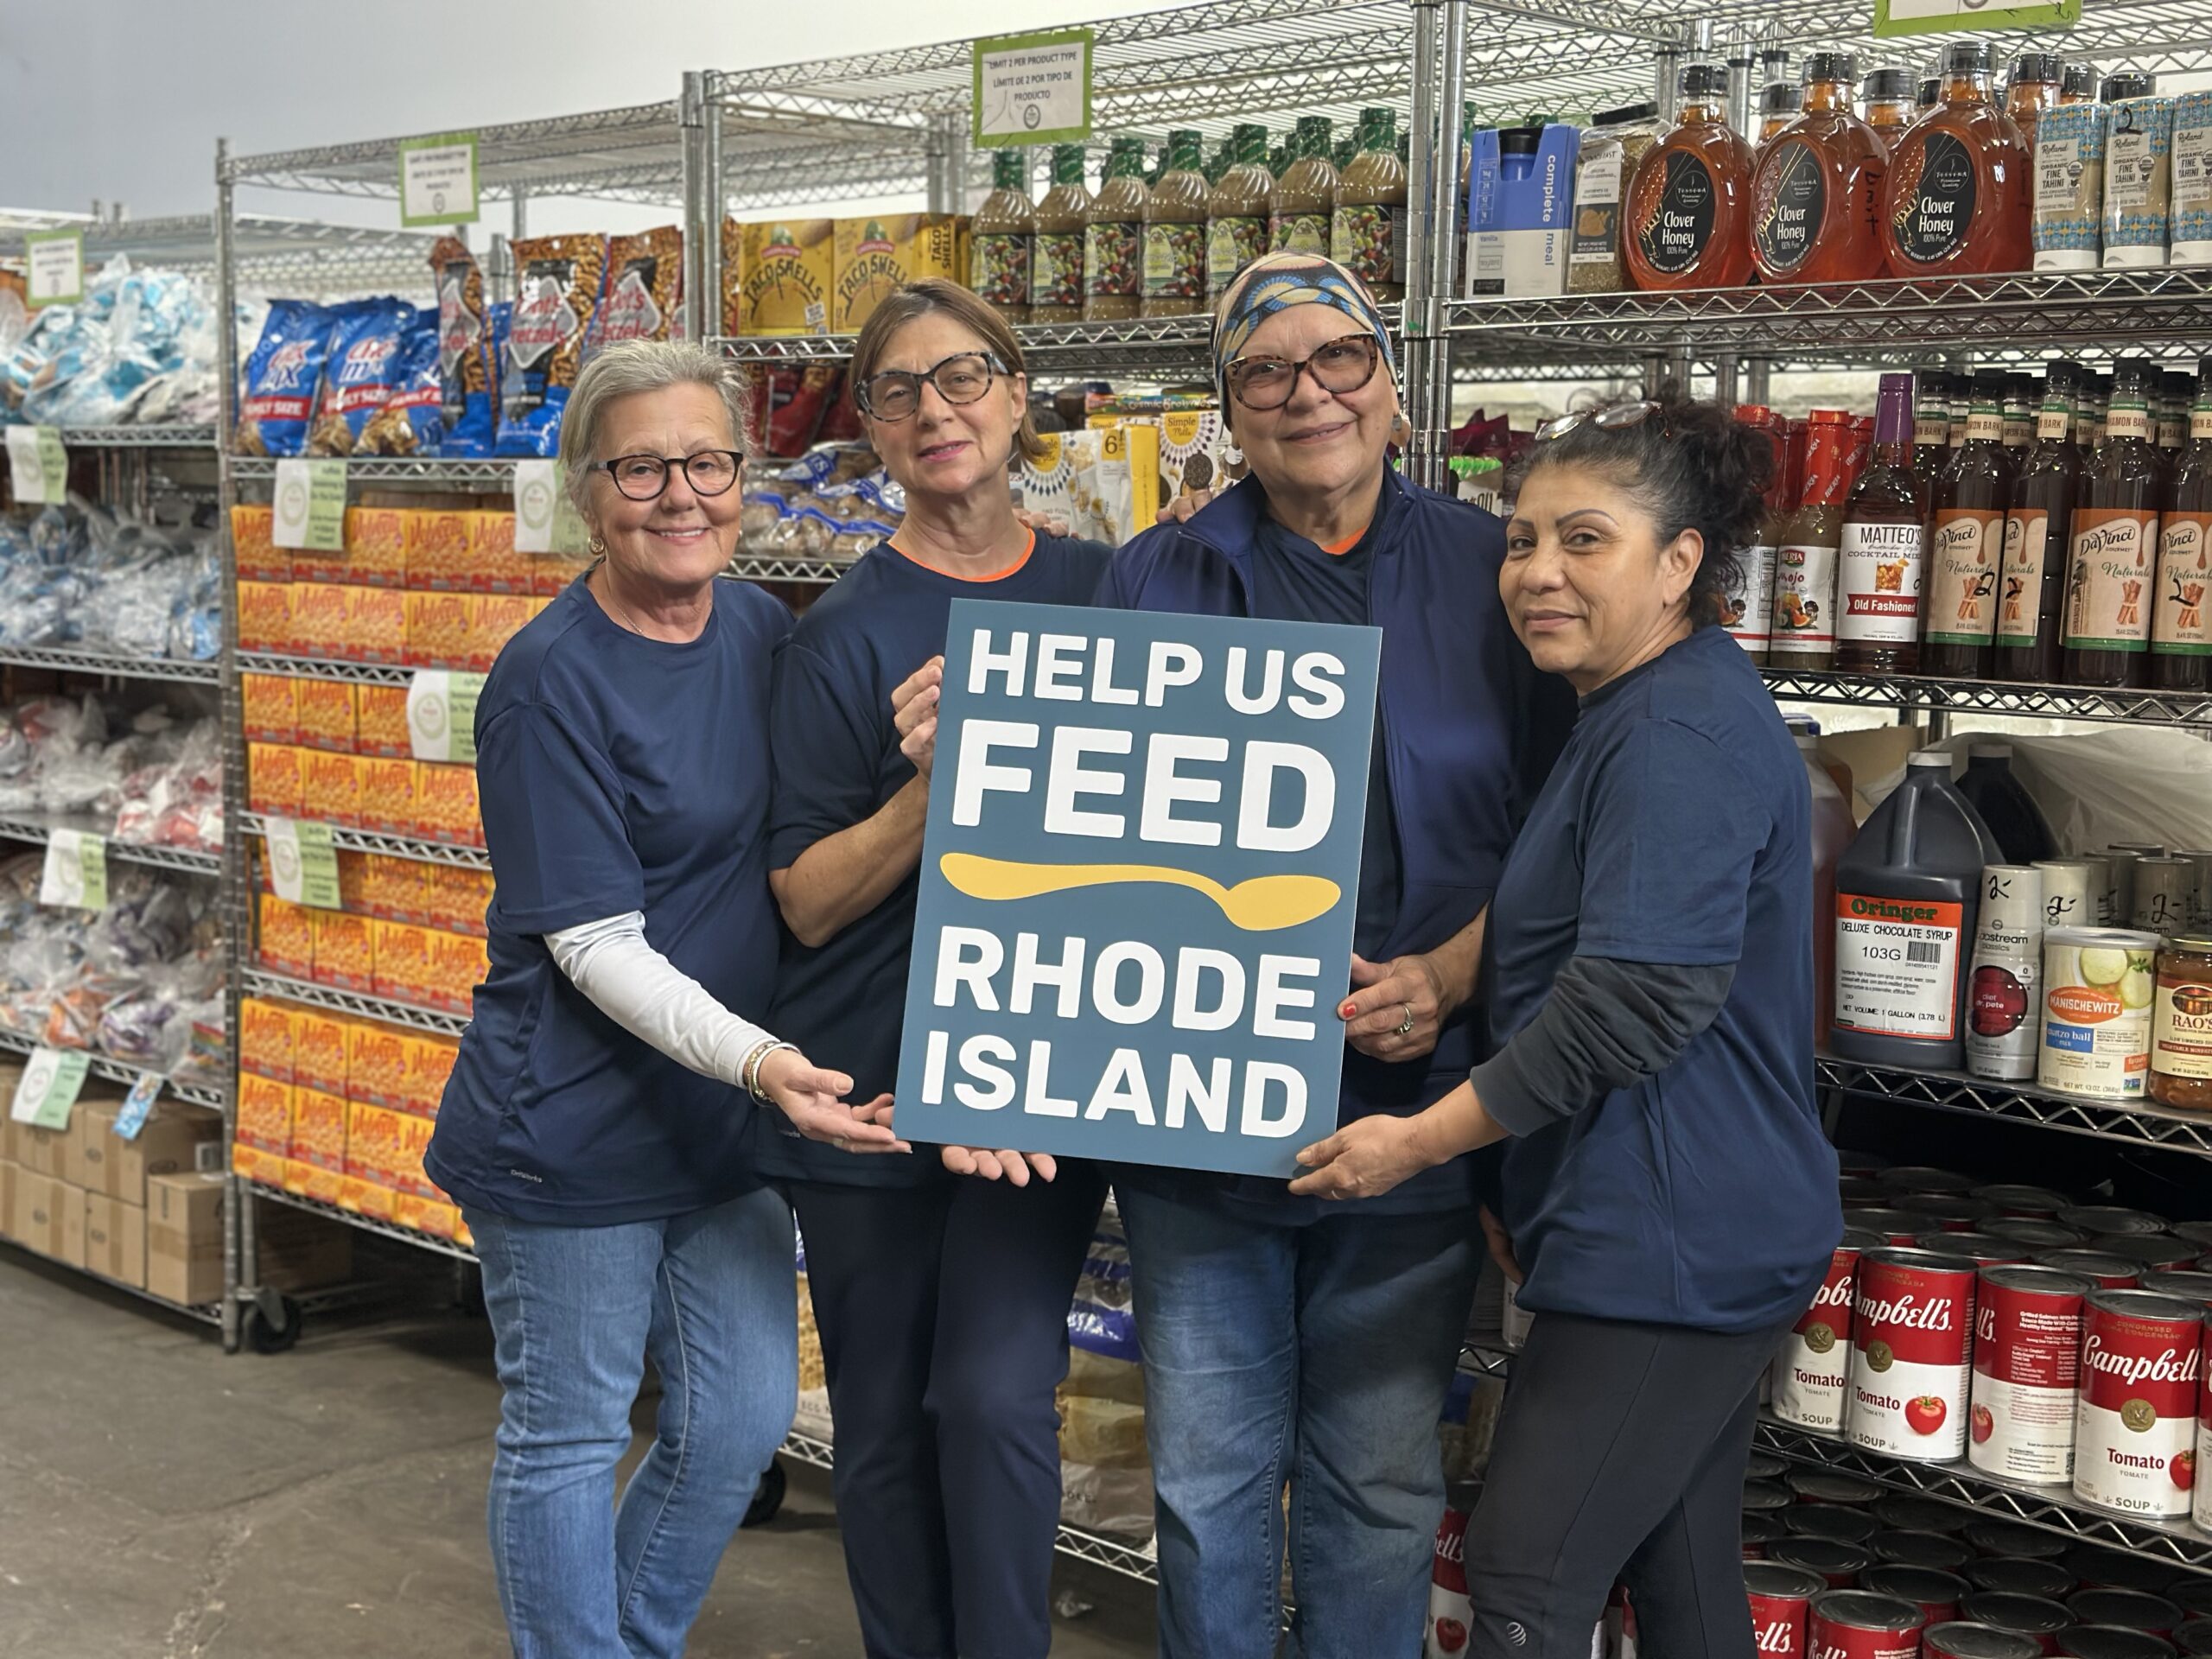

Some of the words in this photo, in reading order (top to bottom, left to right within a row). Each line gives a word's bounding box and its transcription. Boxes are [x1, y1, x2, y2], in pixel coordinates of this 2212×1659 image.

[989, 59, 1007, 69] LIMIT
[1008, 58, 1013, 67] 2
[1014, 57, 1026, 67] PER
[1027, 54, 1059, 65] PRODUCT
[1061, 51, 1077, 62] TYPE
[994, 75, 1014, 87] LÍMITE
[1015, 75, 1026, 86] DE
[1026, 75, 1030, 85] 2
[1031, 73, 1045, 84] POR
[1046, 72, 1062, 82] TIPO
[1064, 70, 1073, 81] DE
[1014, 90, 1051, 102] PRODUCTO
[2116, 105, 2143, 136] 2
[2041, 142, 2069, 155] Roland
[2113, 137, 2139, 149] Roland
[2040, 162, 2069, 171] ORGANIC
[2113, 156, 2140, 165] ORGANIC
[2118, 163, 2133, 174] FINE
[2045, 168, 2062, 180] FINE
[2114, 173, 2136, 183] TAHINI
[1542, 155, 1555, 222] complete
[2042, 178, 2065, 189] TAHINI
[1778, 204, 1807, 222] Clover
[1920, 196, 1955, 214] Clover
[1663, 211, 1695, 229] Clover
[1918, 214, 1954, 237] Honey
[1662, 228, 1695, 249] Honey
[1777, 222, 1806, 243] Honey
[1923, 233, 1935, 243] 100%
[1936, 233, 1947, 242] Pure
[931, 229, 942, 263] TACO
[942, 221, 952, 270] SHELLS
[1544, 232, 1554, 266] meal
[744, 263, 773, 302] TACO
[777, 257, 824, 302] SHELLS
[837, 261, 867, 302] TACO
[870, 254, 907, 283] SHELL
[1128, 398, 1162, 410] Cosmic
[1167, 416, 1197, 428] Simple
[1982, 421, 2000, 432] BARK
[2044, 418, 2062, 429] BARK
[1104, 435, 1118, 454] 6
[1860, 526, 1922, 546] MATTEO'S
[2079, 525, 2136, 557] DaVinci
[1847, 550, 1900, 559] COCKTAIL
[1945, 559, 1993, 575] Naturals
[2165, 565, 2212, 581] Natural
[1973, 571, 1995, 597] 2
[1853, 599, 1869, 610] Old
[1871, 600, 1916, 613] Fashioned
[967, 628, 1204, 708] HELP
[1224, 646, 1346, 720] US
[951, 718, 1337, 853] FEED
[1851, 898, 1939, 923] Oringer
[1840, 922, 1870, 934] DELUXE
[1873, 925, 1923, 939] CHOCOLATE
[1926, 929, 1953, 942] SYRUP
[1861, 945, 1902, 961] 103G
[932, 925, 1321, 1041] RHODE
[1985, 1001, 2005, 1009] pete
[2050, 994, 2120, 1014] MANISCHEWITZ
[1887, 1009, 1916, 1019] GALLON
[2072, 1031, 2091, 1042] ball
[921, 1030, 1308, 1139] ISLAND
[2083, 1335, 2199, 1386] Campbell
[1794, 1368, 1845, 1388] Tomato
[1804, 1388, 1831, 1397] TOMATE
[1856, 1386, 1901, 1411] Tomato
[1801, 1413, 1834, 1426] SOUP
[1862, 1407, 1885, 1419] TOMATE
[1858, 1433, 1886, 1449] SOUP
[2107, 1446, 2165, 1470] Tomato
[2120, 1470, 2149, 1480] TOMATE
[2114, 1496, 2152, 1510] SOUP
